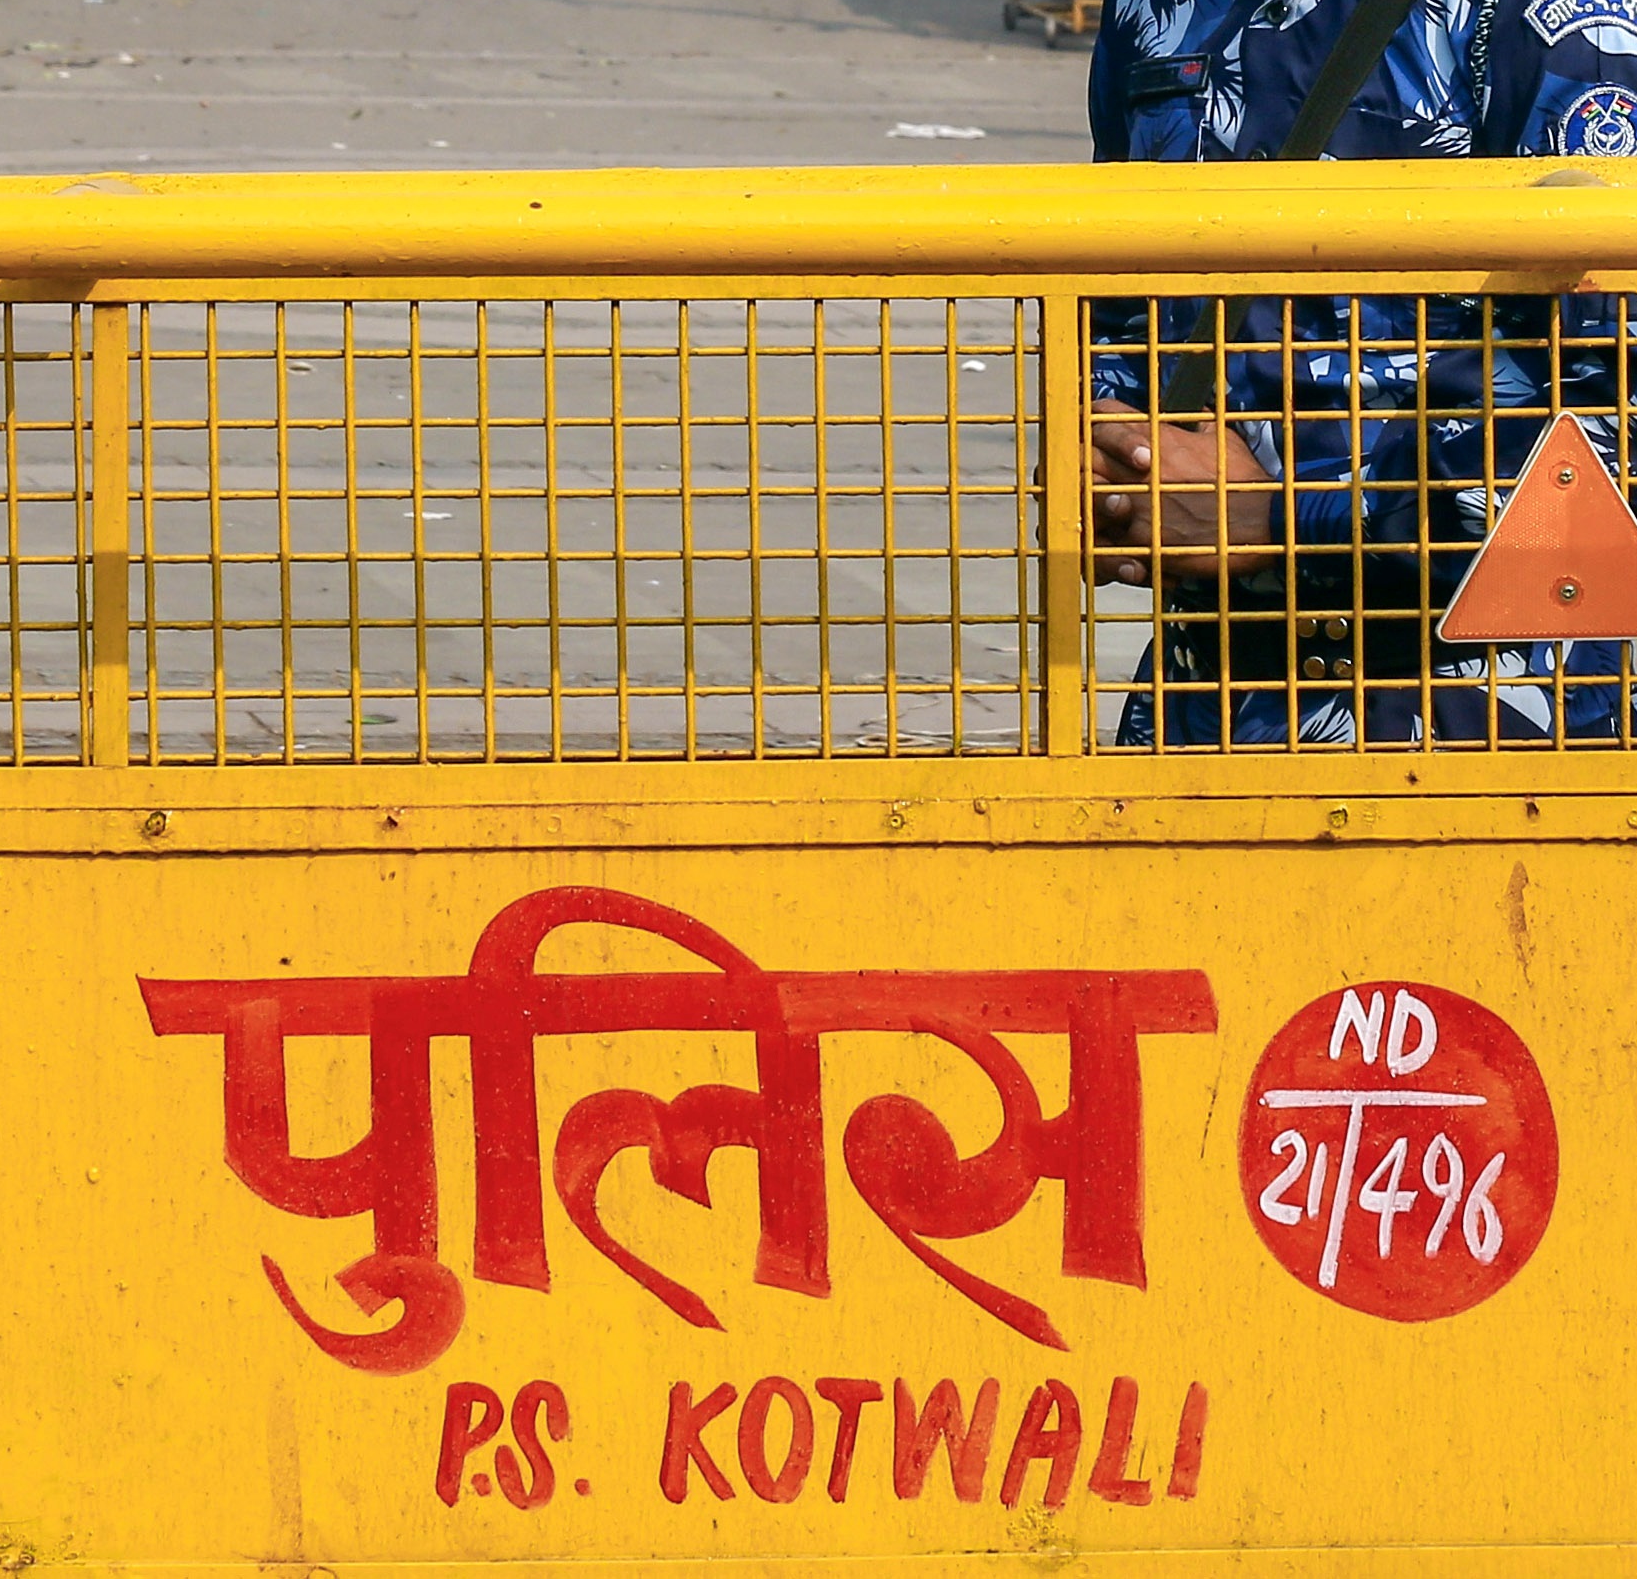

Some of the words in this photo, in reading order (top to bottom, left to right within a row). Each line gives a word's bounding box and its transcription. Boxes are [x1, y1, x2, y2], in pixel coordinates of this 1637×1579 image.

[1329, 988, 1438, 1077] ND
[136, 884, 1219, 1376] पुलिस
[435, 1378, 592, 1509] P.S.
[657, 1374, 1209, 1511] KOTWALI
